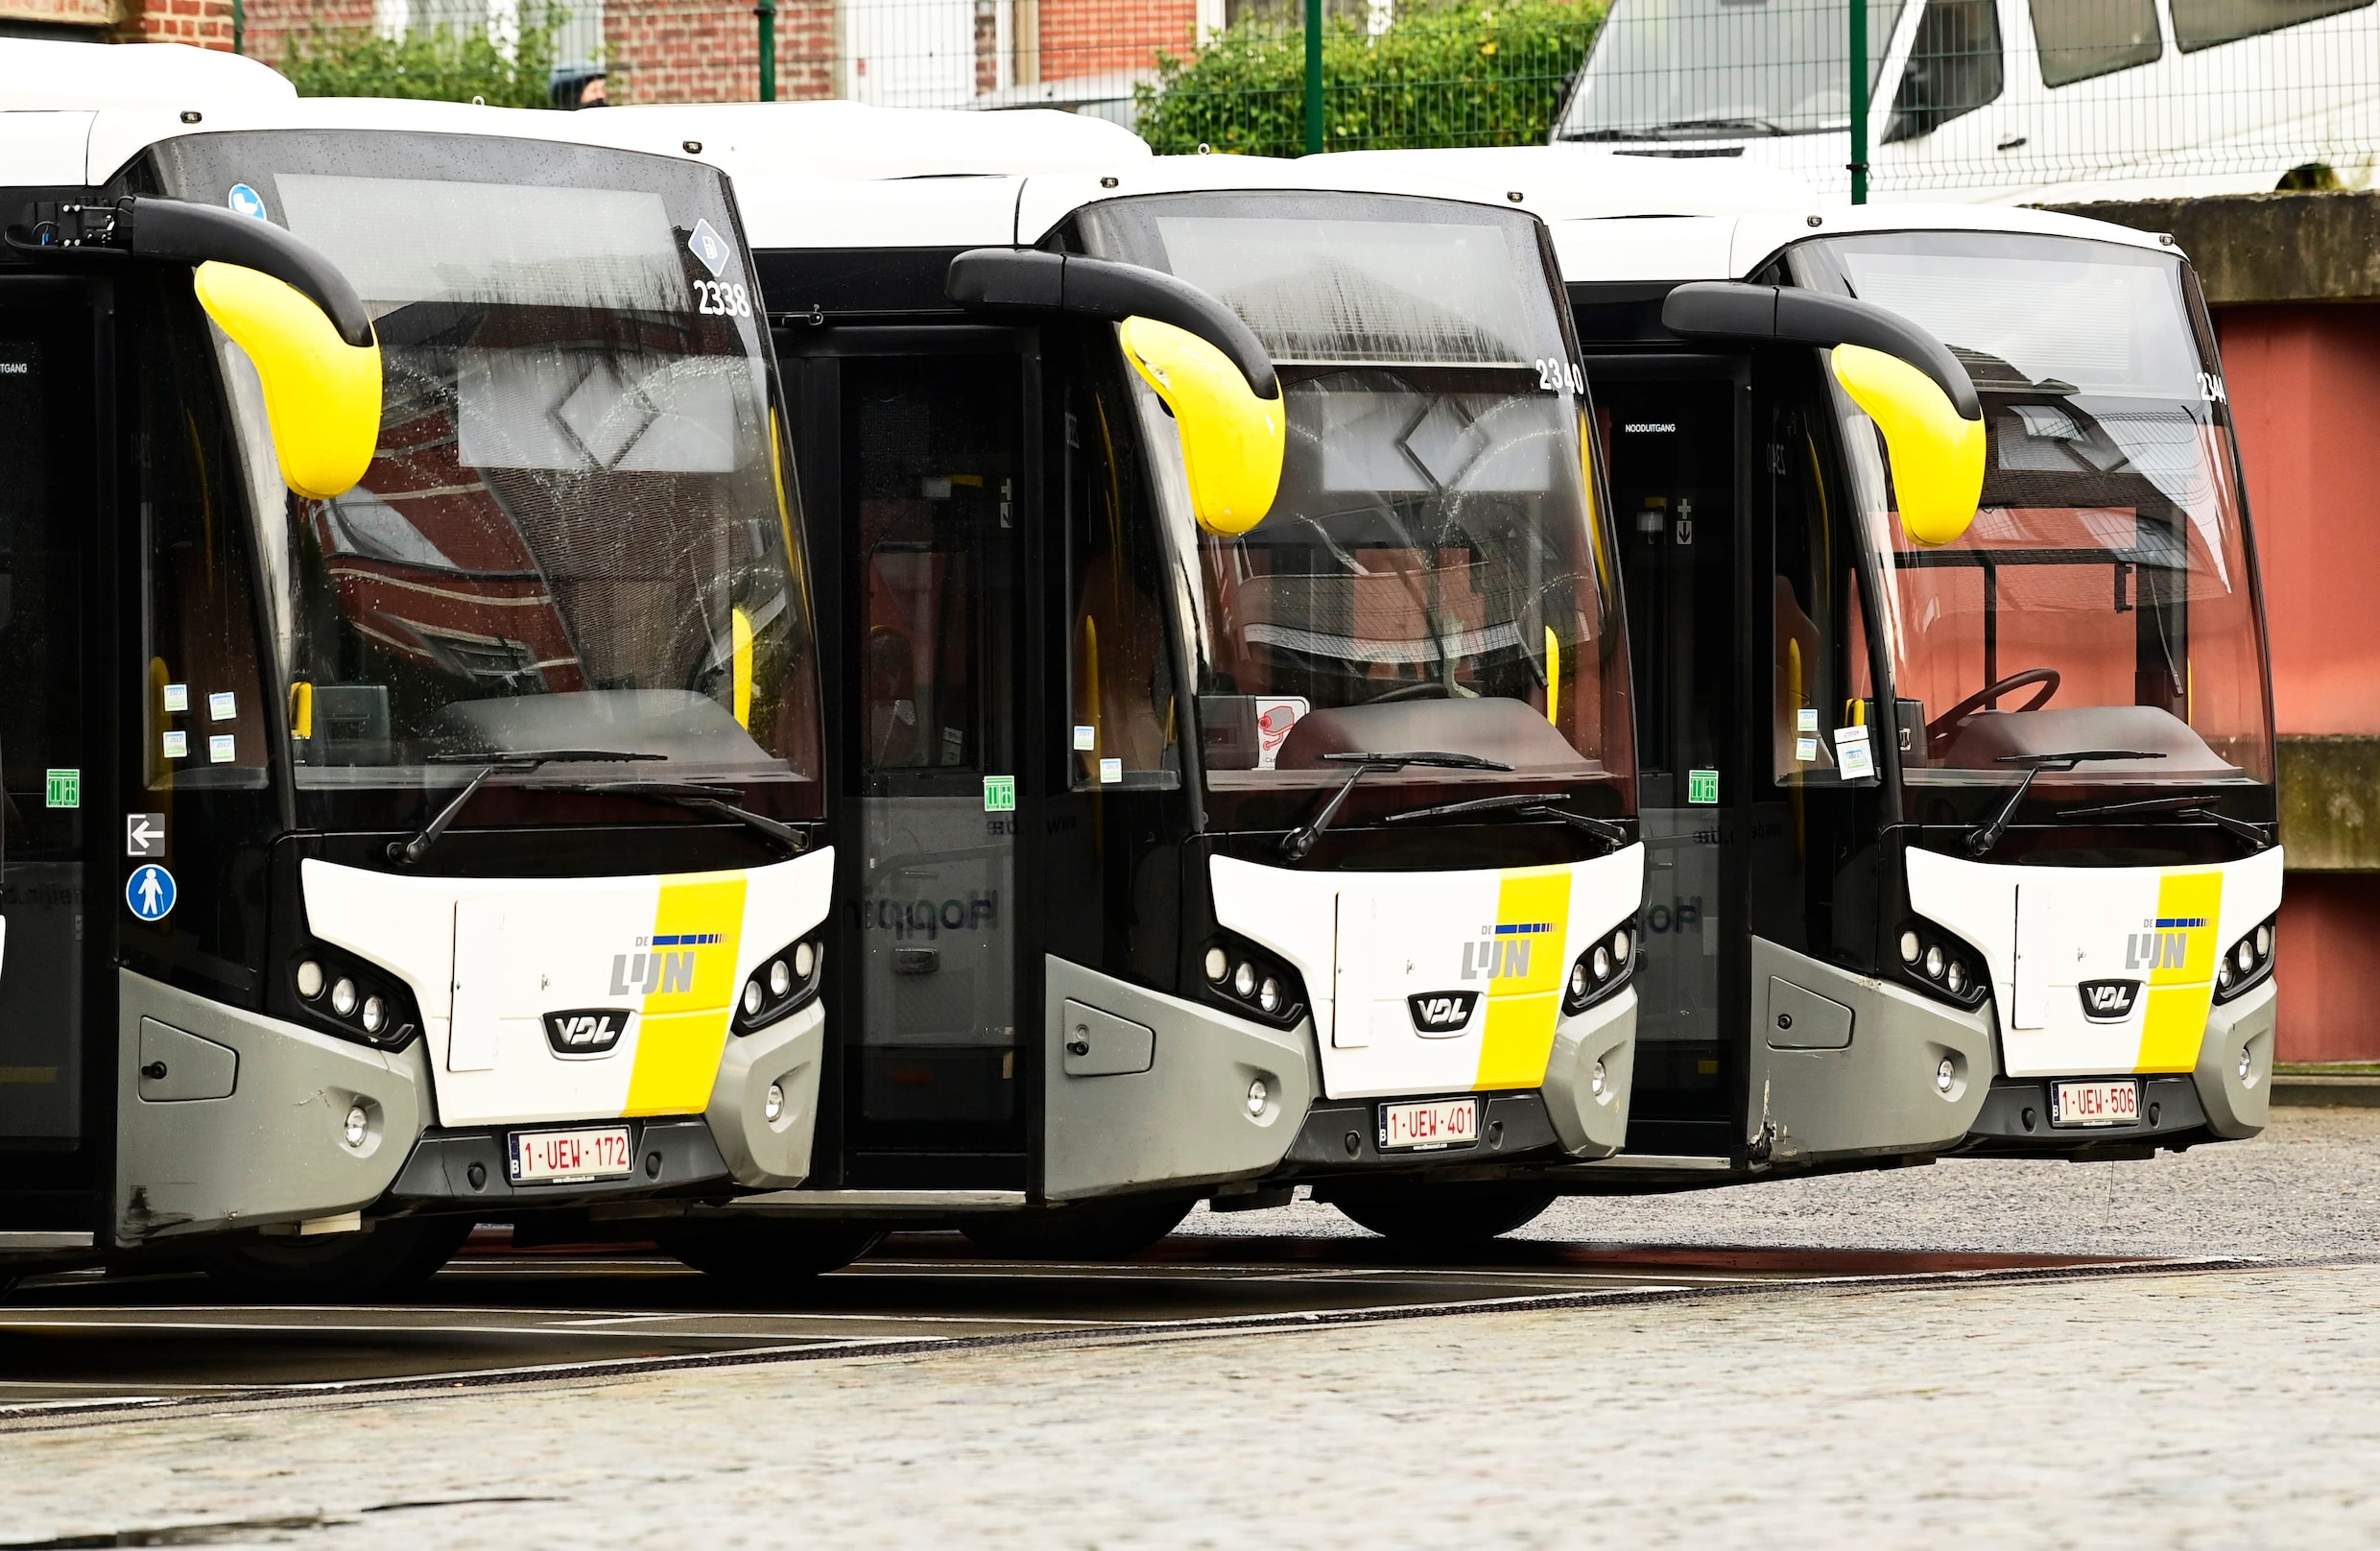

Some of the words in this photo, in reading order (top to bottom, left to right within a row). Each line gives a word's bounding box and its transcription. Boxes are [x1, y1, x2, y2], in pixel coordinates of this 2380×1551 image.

[693, 279, 750, 318] 2338
[0, 363, 28, 374] TGANG
[1535, 357, 1584, 395] 2340
[2196, 371, 2227, 405] 2344
[1625, 423, 1677, 433] NOODUITGANG
[1481, 925, 1493, 935] DE
[2143, 919, 2154, 928] DE
[635, 936, 649, 947] DE
[2125, 932, 2187, 969] LIJN
[1461, 939, 1531, 980] LIJN
[608, 951, 696, 996] LIJN
[1416, 997, 1467, 1025] VDL
[2086, 986, 2130, 1011] VDL
[555, 1015, 616, 1045] VDL
[2053, 1105, 2059, 1117] B
[1380, 1128, 1387, 1142] B
[512, 1158, 520, 1174] B
